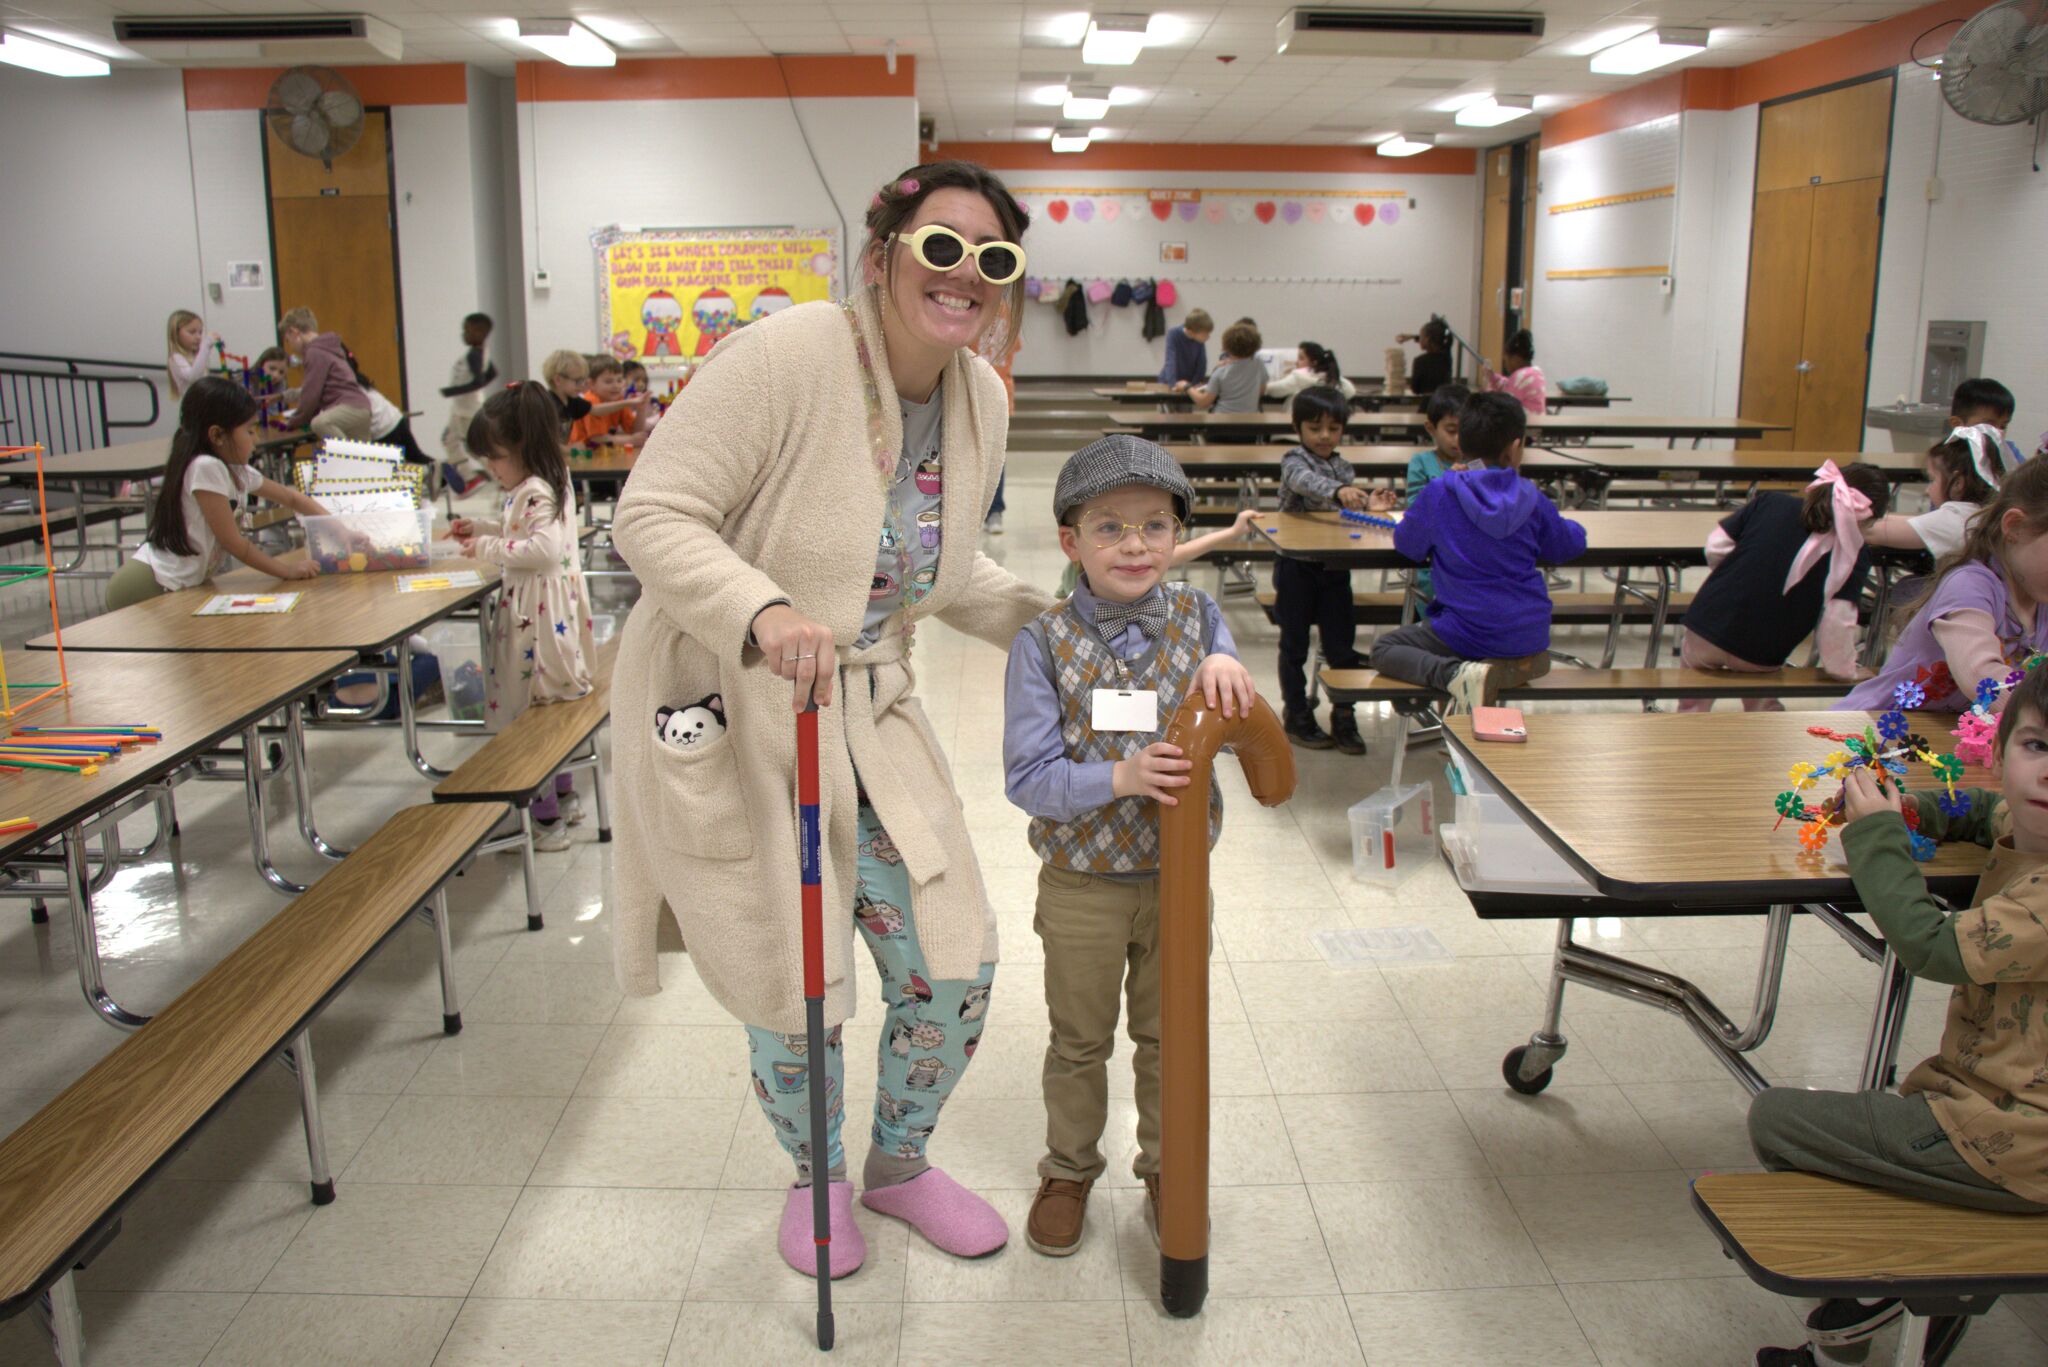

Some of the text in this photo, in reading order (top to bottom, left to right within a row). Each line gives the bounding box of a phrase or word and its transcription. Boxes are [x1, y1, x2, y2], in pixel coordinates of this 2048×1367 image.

[613, 245, 644, 260] LET'S
[650, 245, 671, 258] SEE
[718, 243, 778, 257] BEHAVIOR
[782, 241, 813, 254] WILL
[611, 261, 643, 275] BLOW
[646, 261, 662, 273] US
[666, 260, 697, 273] AWAY
[700, 259, 724, 272] AND
[757, 257, 793, 271] THEIR
[616, 275, 641, 288] GUM
[643, 274, 673, 288] BALL
[675, 273, 732, 287] MACHINE
[736, 272, 770, 287] FIRST
